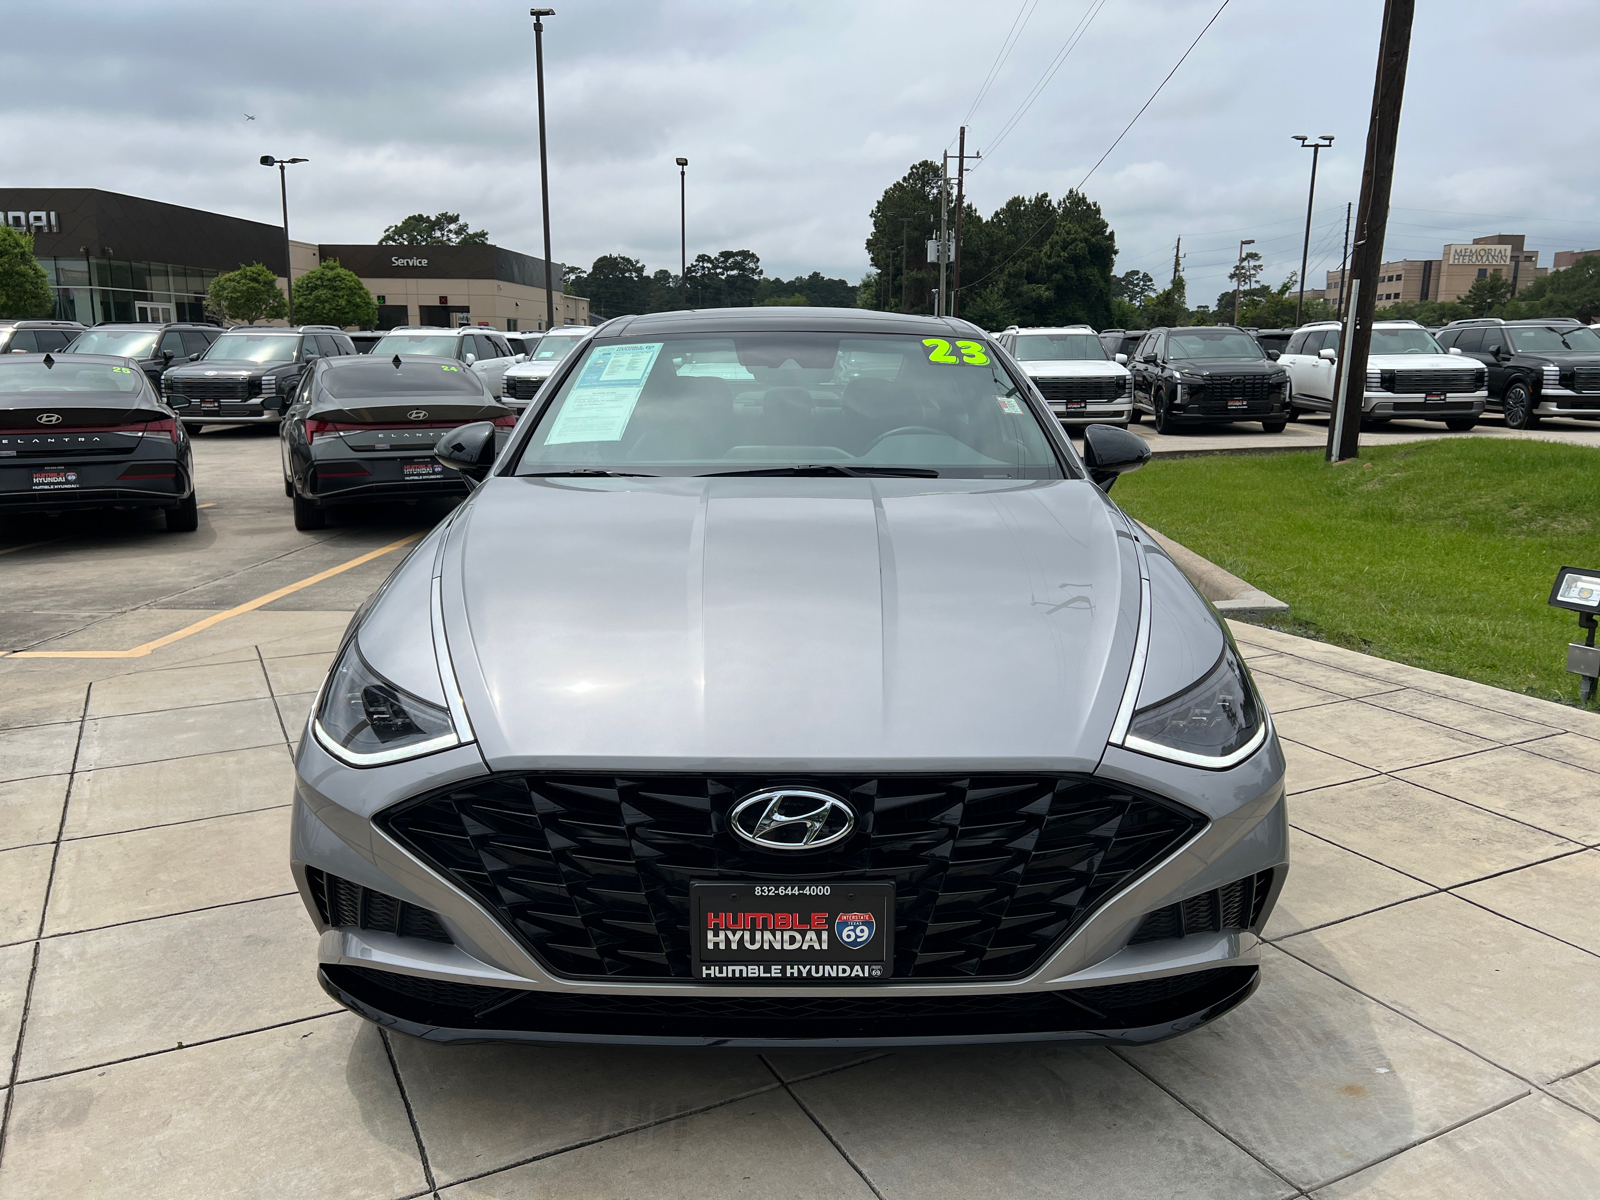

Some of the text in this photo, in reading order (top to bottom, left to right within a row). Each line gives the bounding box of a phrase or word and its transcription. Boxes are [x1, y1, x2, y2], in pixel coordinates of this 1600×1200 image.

[1454, 248, 1507, 257] MEMORIAL
[391, 256, 428, 267] Service
[1453, 255, 1508, 263] HERMANN
[922, 338, 991, 366] 23
[112, 366, 131, 374] 25
[754, 886, 831, 896] 832-644-4000
[707, 912, 829, 930] HUMBLE
[842, 925, 869, 942] 69
[707, 930, 829, 950] HYUNDAI
[702, 965, 782, 978] HUMBLE
[786, 965, 869, 977] HYUNDAI
